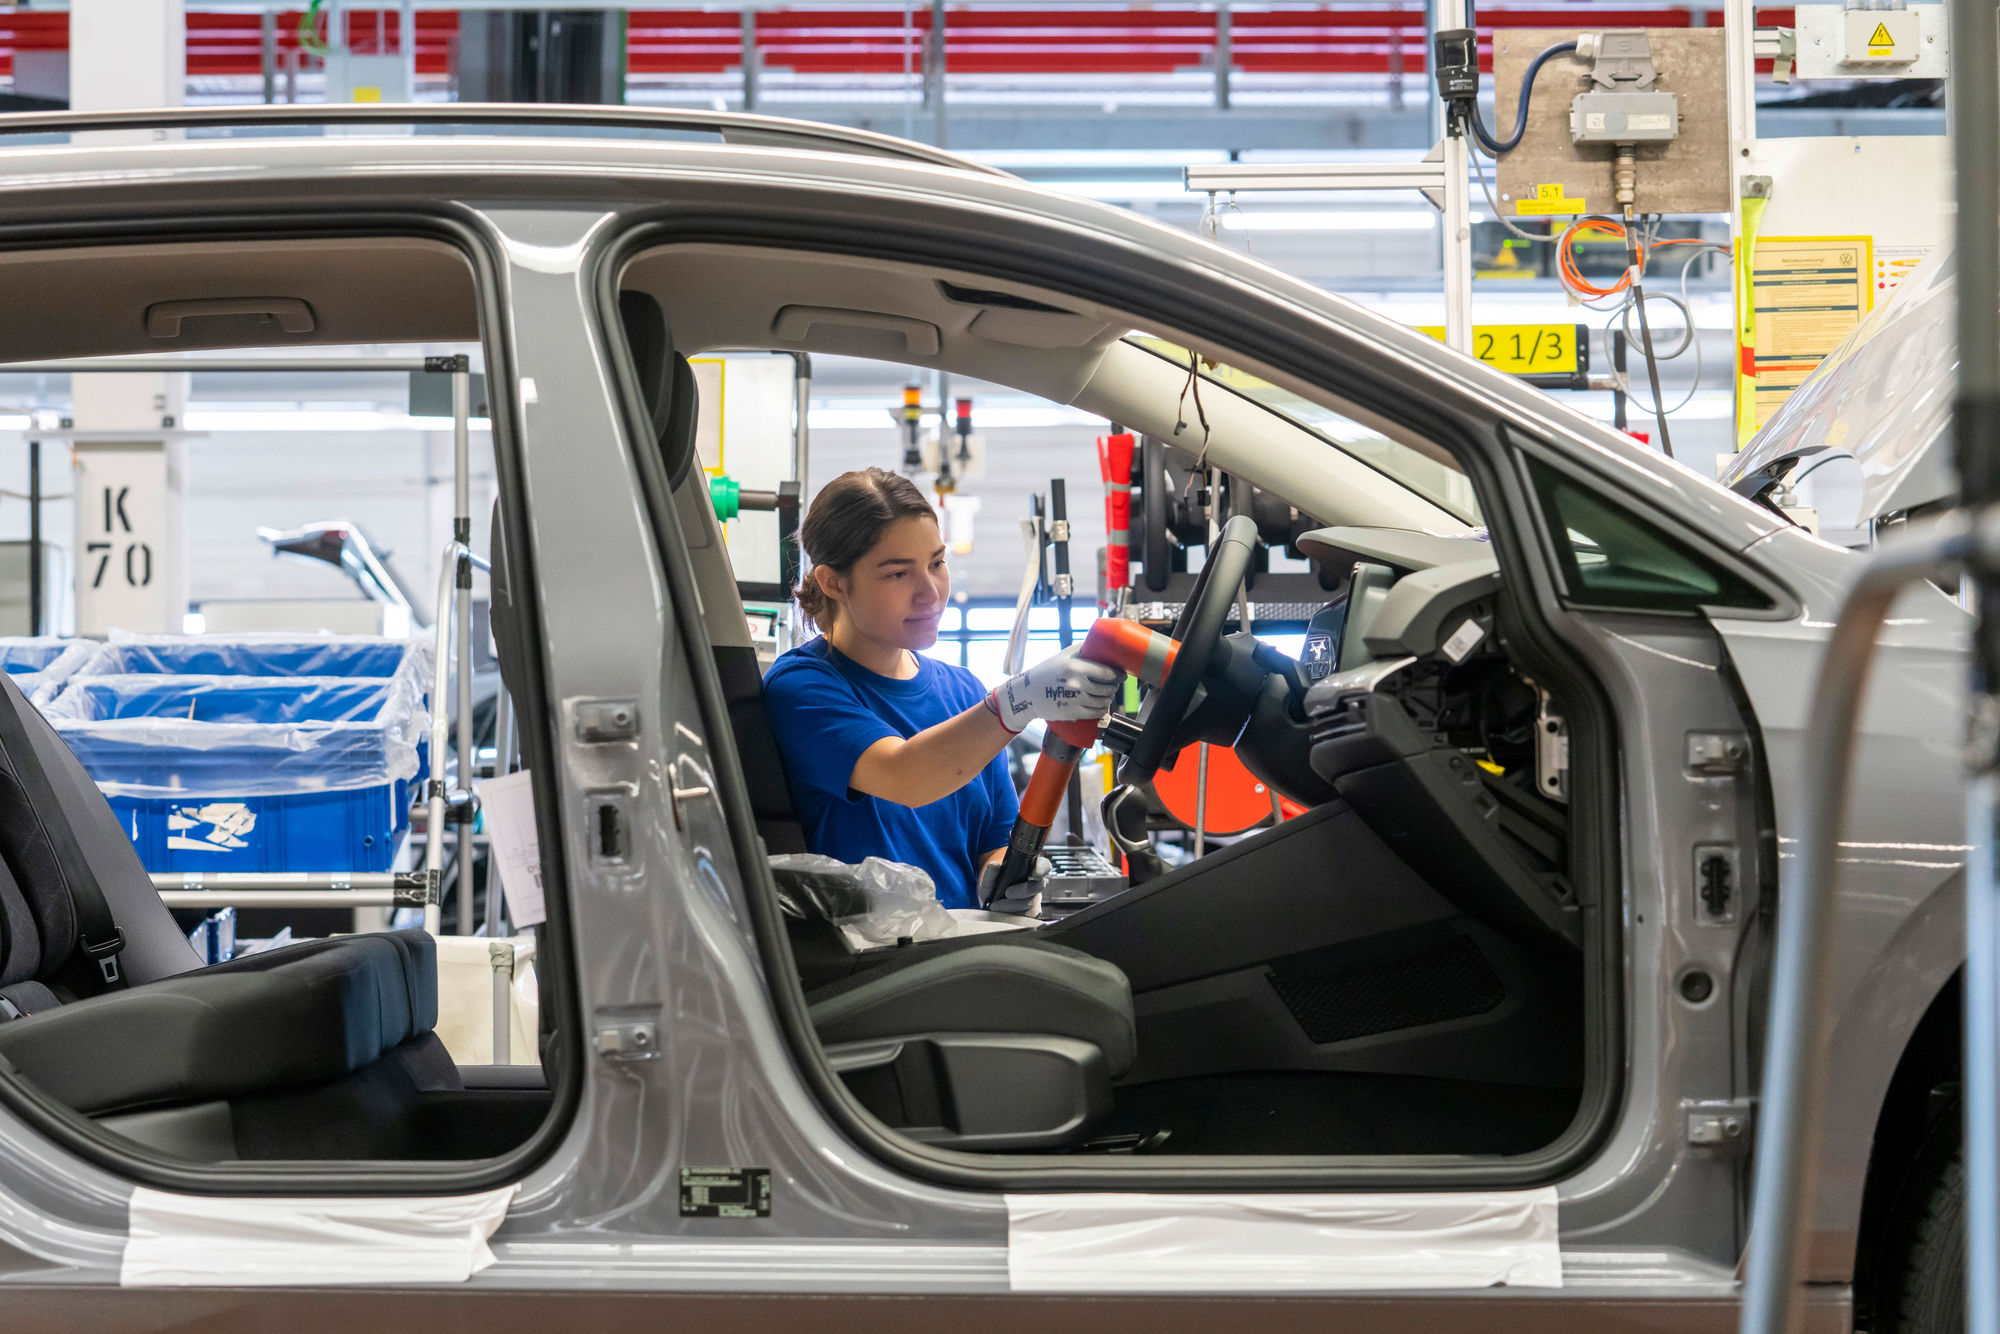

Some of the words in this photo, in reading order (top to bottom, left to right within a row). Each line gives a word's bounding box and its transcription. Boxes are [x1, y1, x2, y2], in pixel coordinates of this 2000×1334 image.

[1541, 186, 1559, 198] 5.1
[1478, 333, 1495, 360] 2
[1510, 330, 1563, 365] 1/3
[105, 487, 132, 532] K
[86, 543, 152, 589] 70
